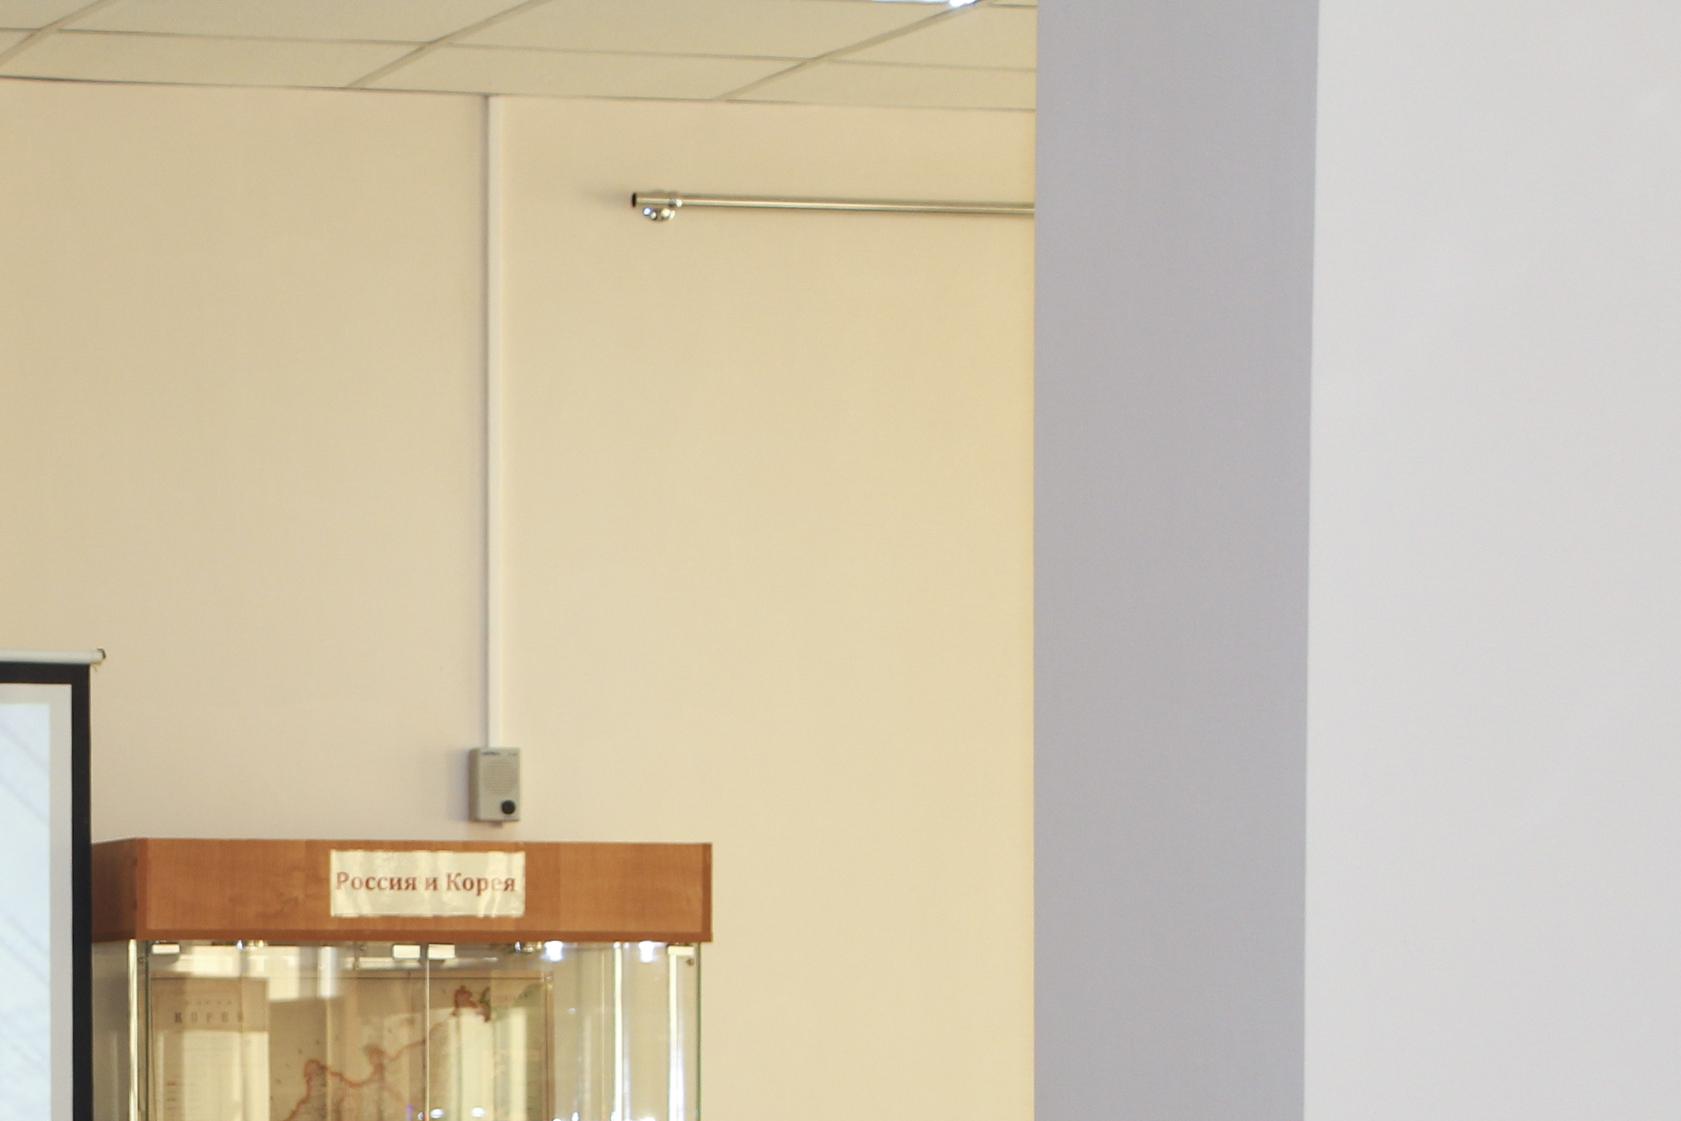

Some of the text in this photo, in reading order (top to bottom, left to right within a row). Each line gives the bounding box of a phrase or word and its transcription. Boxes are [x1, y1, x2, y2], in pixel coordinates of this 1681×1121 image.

[336, 871, 517, 897] Россия и Корея
